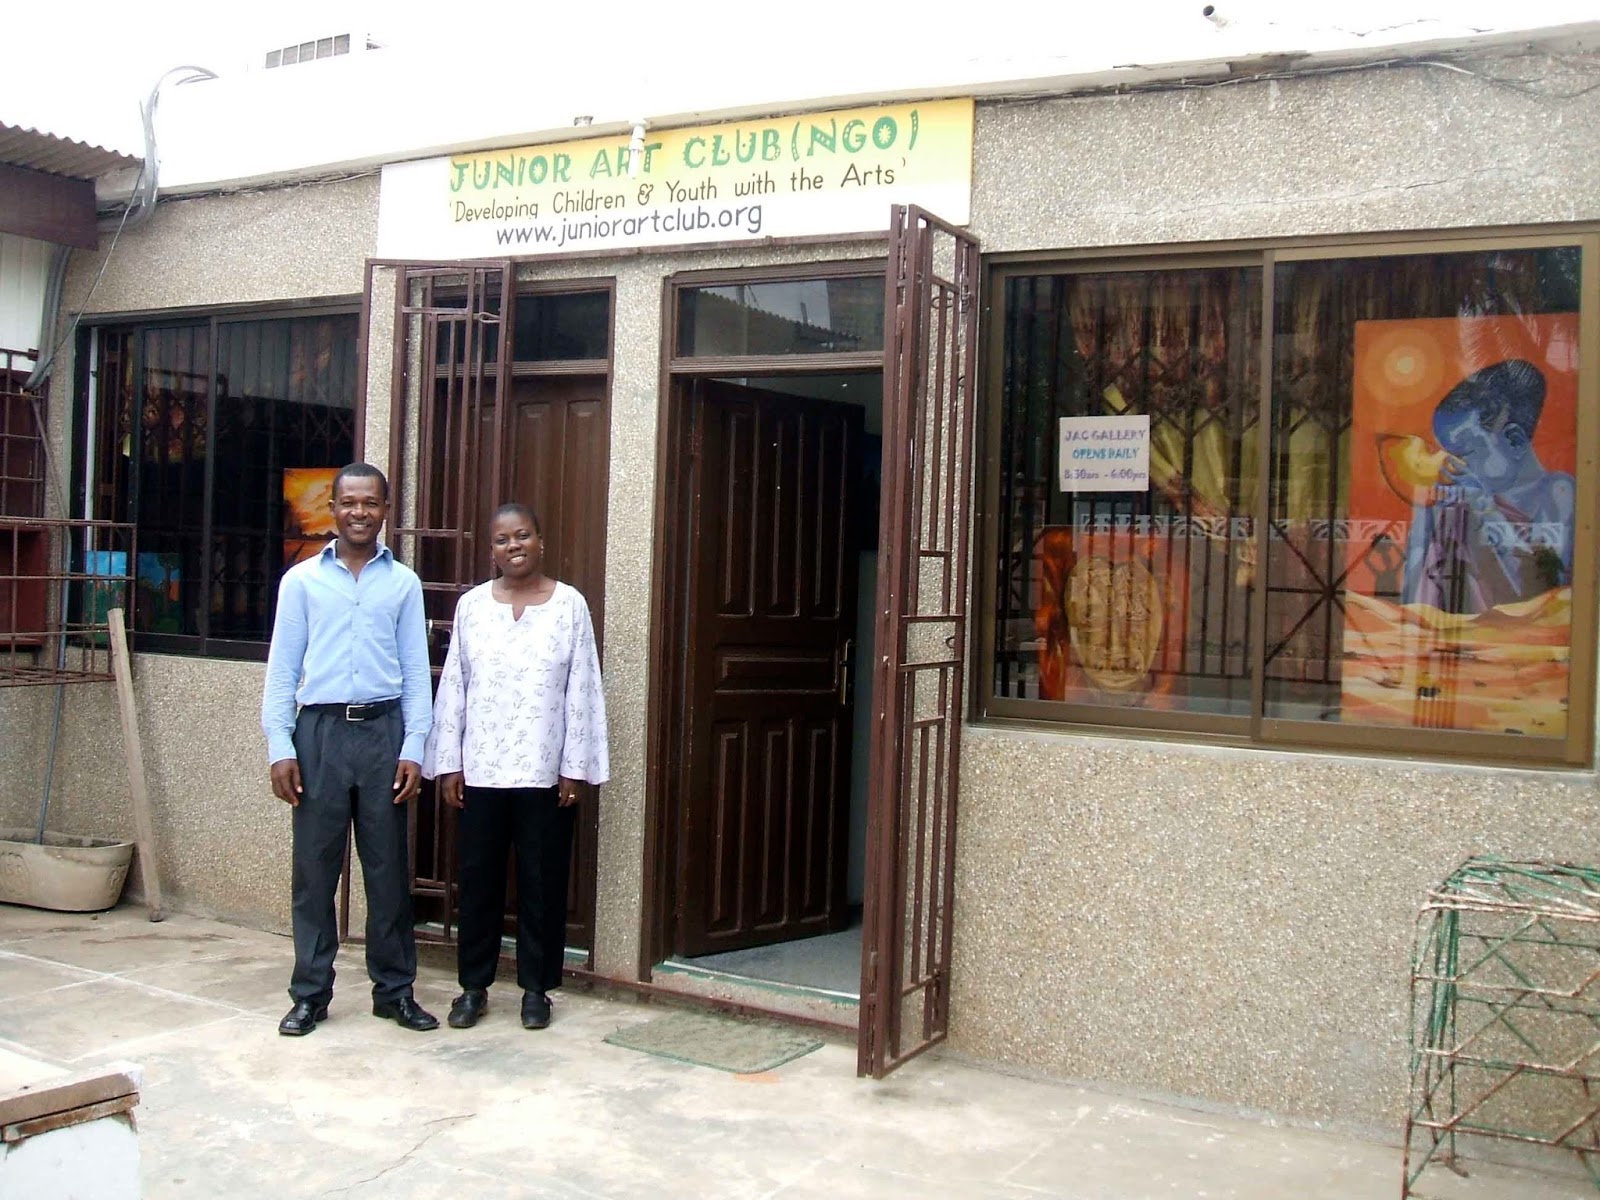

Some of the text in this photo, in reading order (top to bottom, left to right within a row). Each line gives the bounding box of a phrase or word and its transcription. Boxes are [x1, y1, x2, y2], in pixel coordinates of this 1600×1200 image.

[450, 152, 572, 193] JUNIOR
[552, 188, 626, 214] Children
[637, 183, 655, 206] &
[665, 176, 719, 203] Youth
[734, 170, 776, 198] with
[790, 167, 825, 192] the
[496, 205, 763, 248] www.juniorartclub.org
[1072, 447, 1140, 460] OPENS DAILY
[1091, 430, 1146, 441] GALLERY
